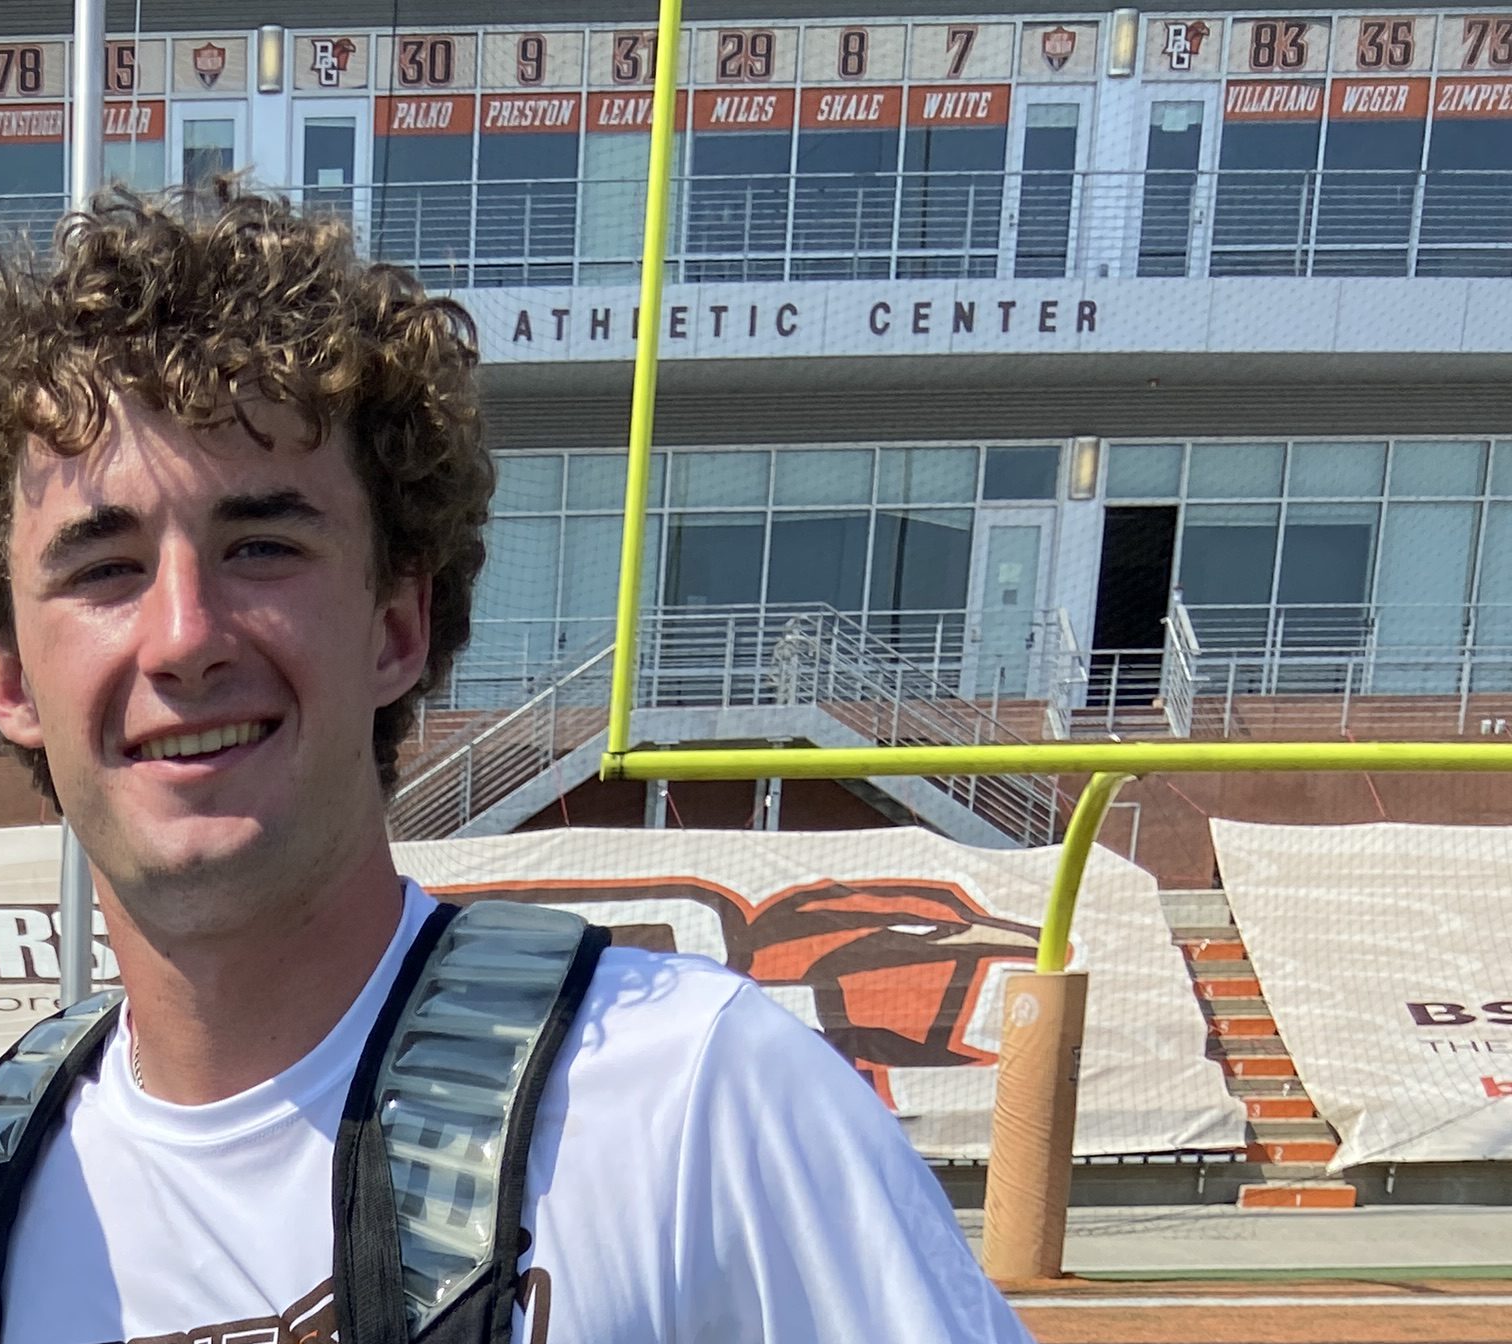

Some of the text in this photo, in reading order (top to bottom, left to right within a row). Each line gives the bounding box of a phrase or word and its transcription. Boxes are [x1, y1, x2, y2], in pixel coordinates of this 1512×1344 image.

[717, 29, 776, 82] 29
[838, 25, 868, 80] 8
[946, 24, 979, 79] 7
[1249, 20, 1310, 72] 83
[1356, 17, 1416, 70] 35
[398, 35, 456, 87] 30
[517, 32, 547, 86] 9
[598, 98, 655, 125] LEAV
[709, 95, 778, 123] MILES
[816, 93, 884, 121] SHALE
[921, 91, 992, 119] WHITE
[1341, 85, 1410, 113] WEGER
[1437, 84, 1512, 111] ZIMPFE
[104, 107, 152, 135] LLER
[484, 99, 576, 128] PRESTON
[513, 300, 1098, 342] ATHETIC CENTER
[1251, 1104, 1261, 1118] 3
[1273, 1146, 1283, 1162] 2
